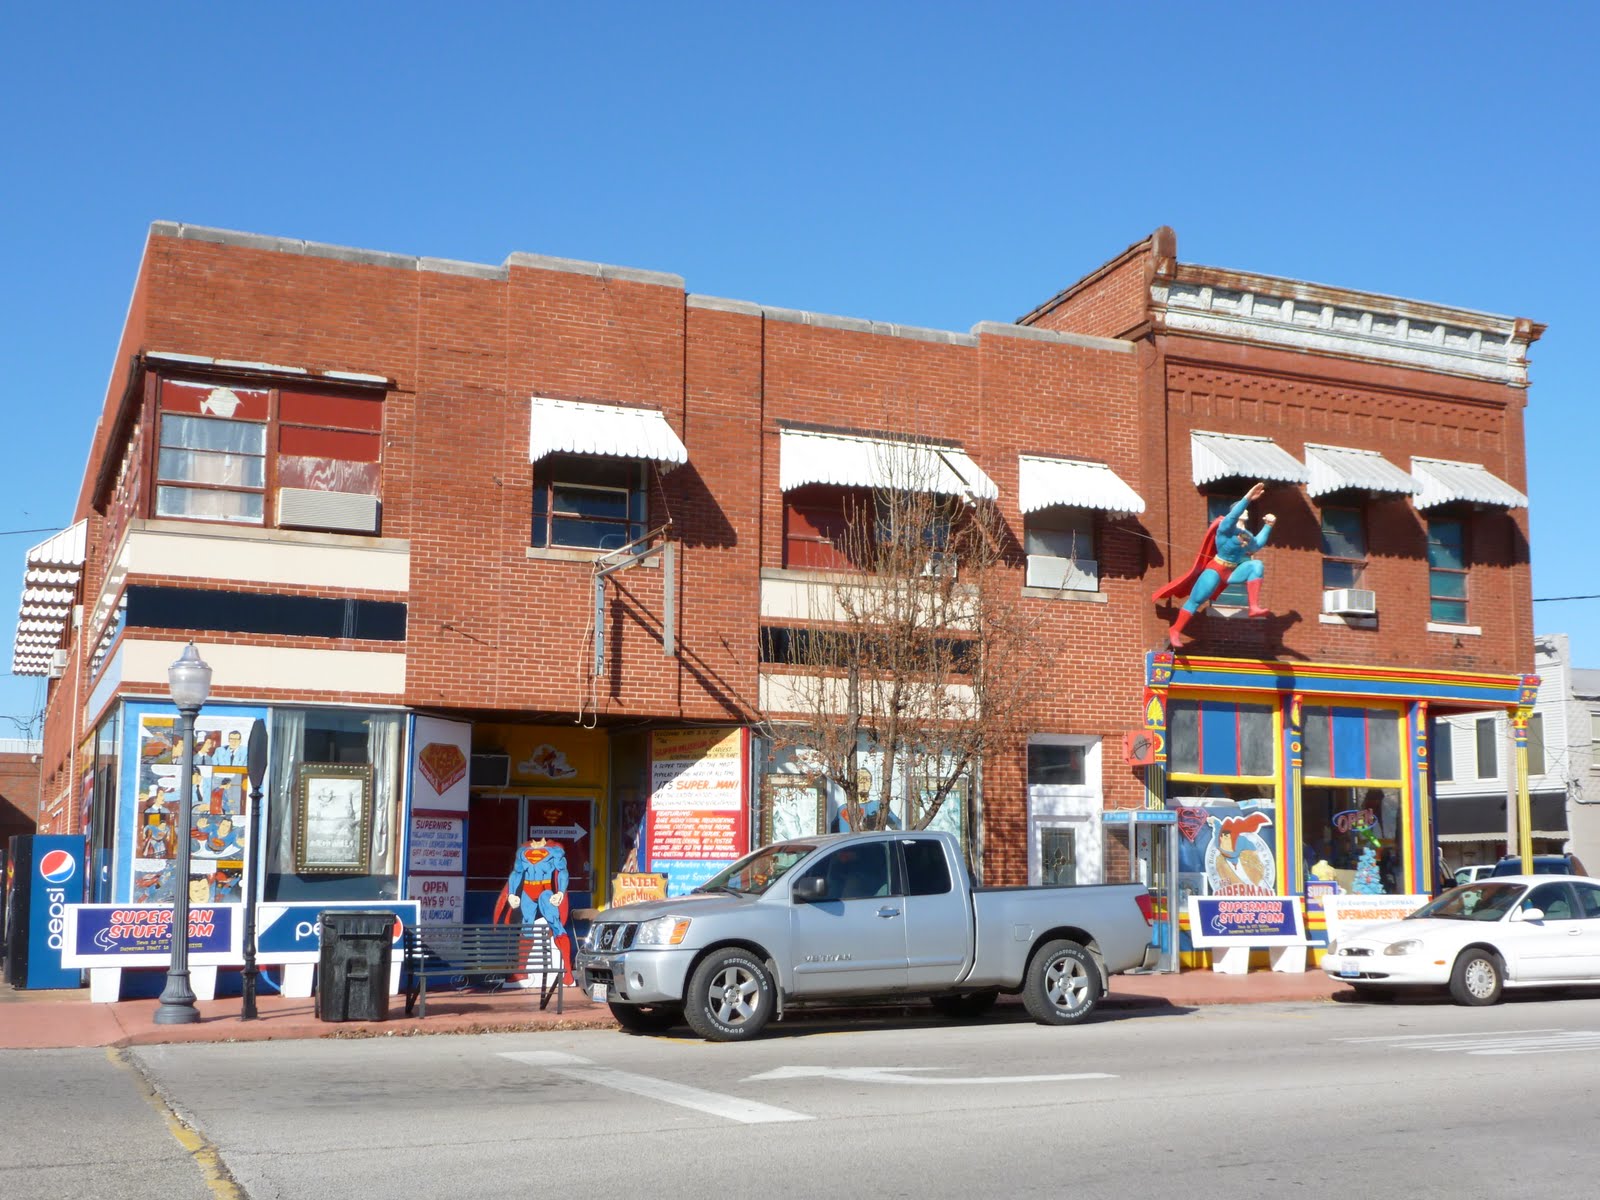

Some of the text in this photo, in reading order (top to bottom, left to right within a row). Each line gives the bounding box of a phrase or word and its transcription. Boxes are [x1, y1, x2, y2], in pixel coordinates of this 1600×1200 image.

[1337, 808, 1374, 833] OPEN
[422, 880, 449, 894] OPEN
[621, 876, 659, 889] ENTER
[1218, 901, 1282, 912] SUPERMAN
[47, 886, 66, 951] pepsi
[109, 909, 215, 925] SUPERAN
[1219, 912, 1285, 924] STUFF.COM
[108, 923, 216, 939] STUFF.OM
[723, 958, 765, 980] DESTINATION
